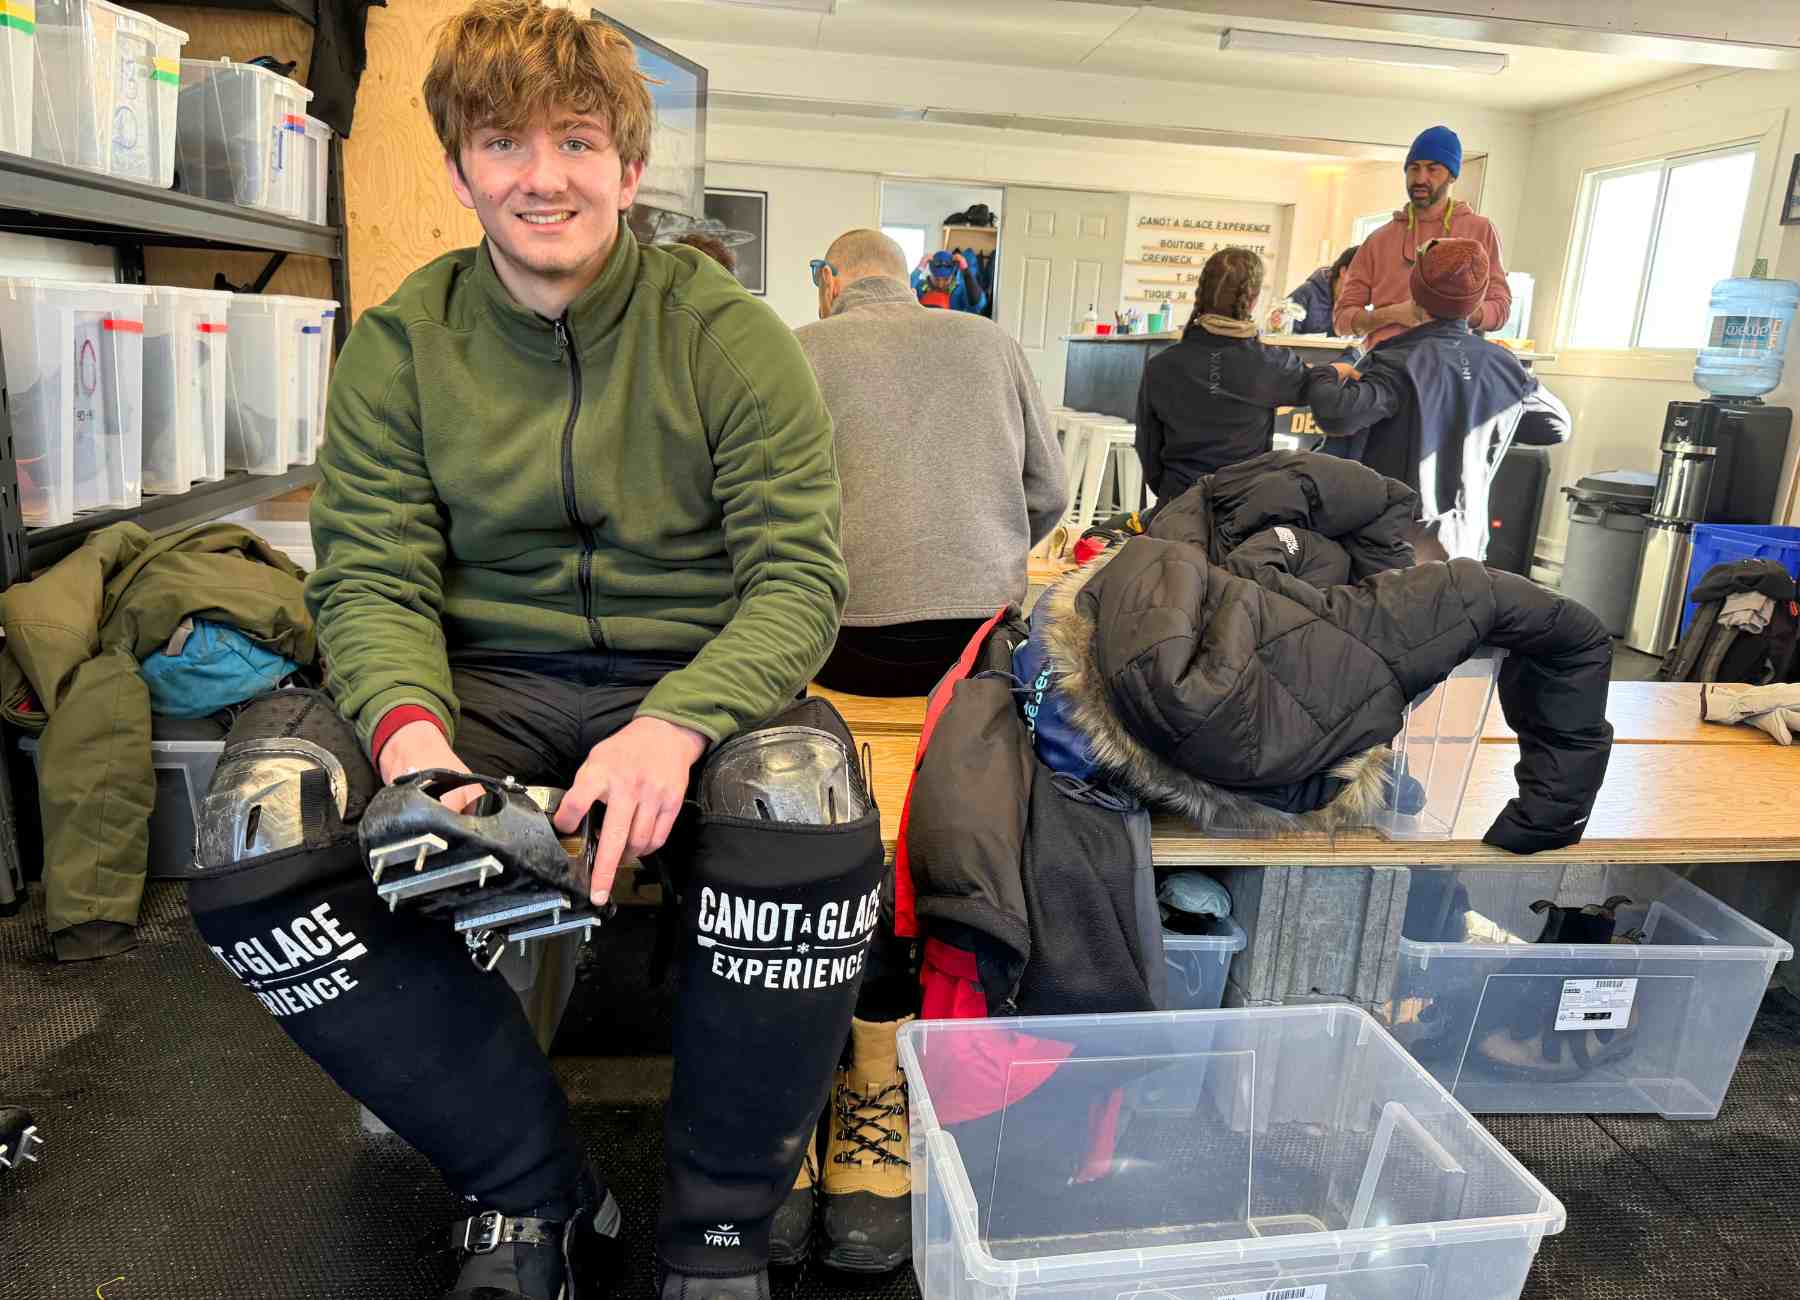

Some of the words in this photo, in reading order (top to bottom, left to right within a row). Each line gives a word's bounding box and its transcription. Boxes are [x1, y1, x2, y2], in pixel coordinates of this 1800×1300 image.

[1160, 239, 1204, 250] BOUTIQUE
[1142, 254, 1192, 264] CREWNECK
[699, 886, 803, 942] CANOT
[234, 902, 356, 976] GLACE
[704, 1233, 741, 1247] YRVA
